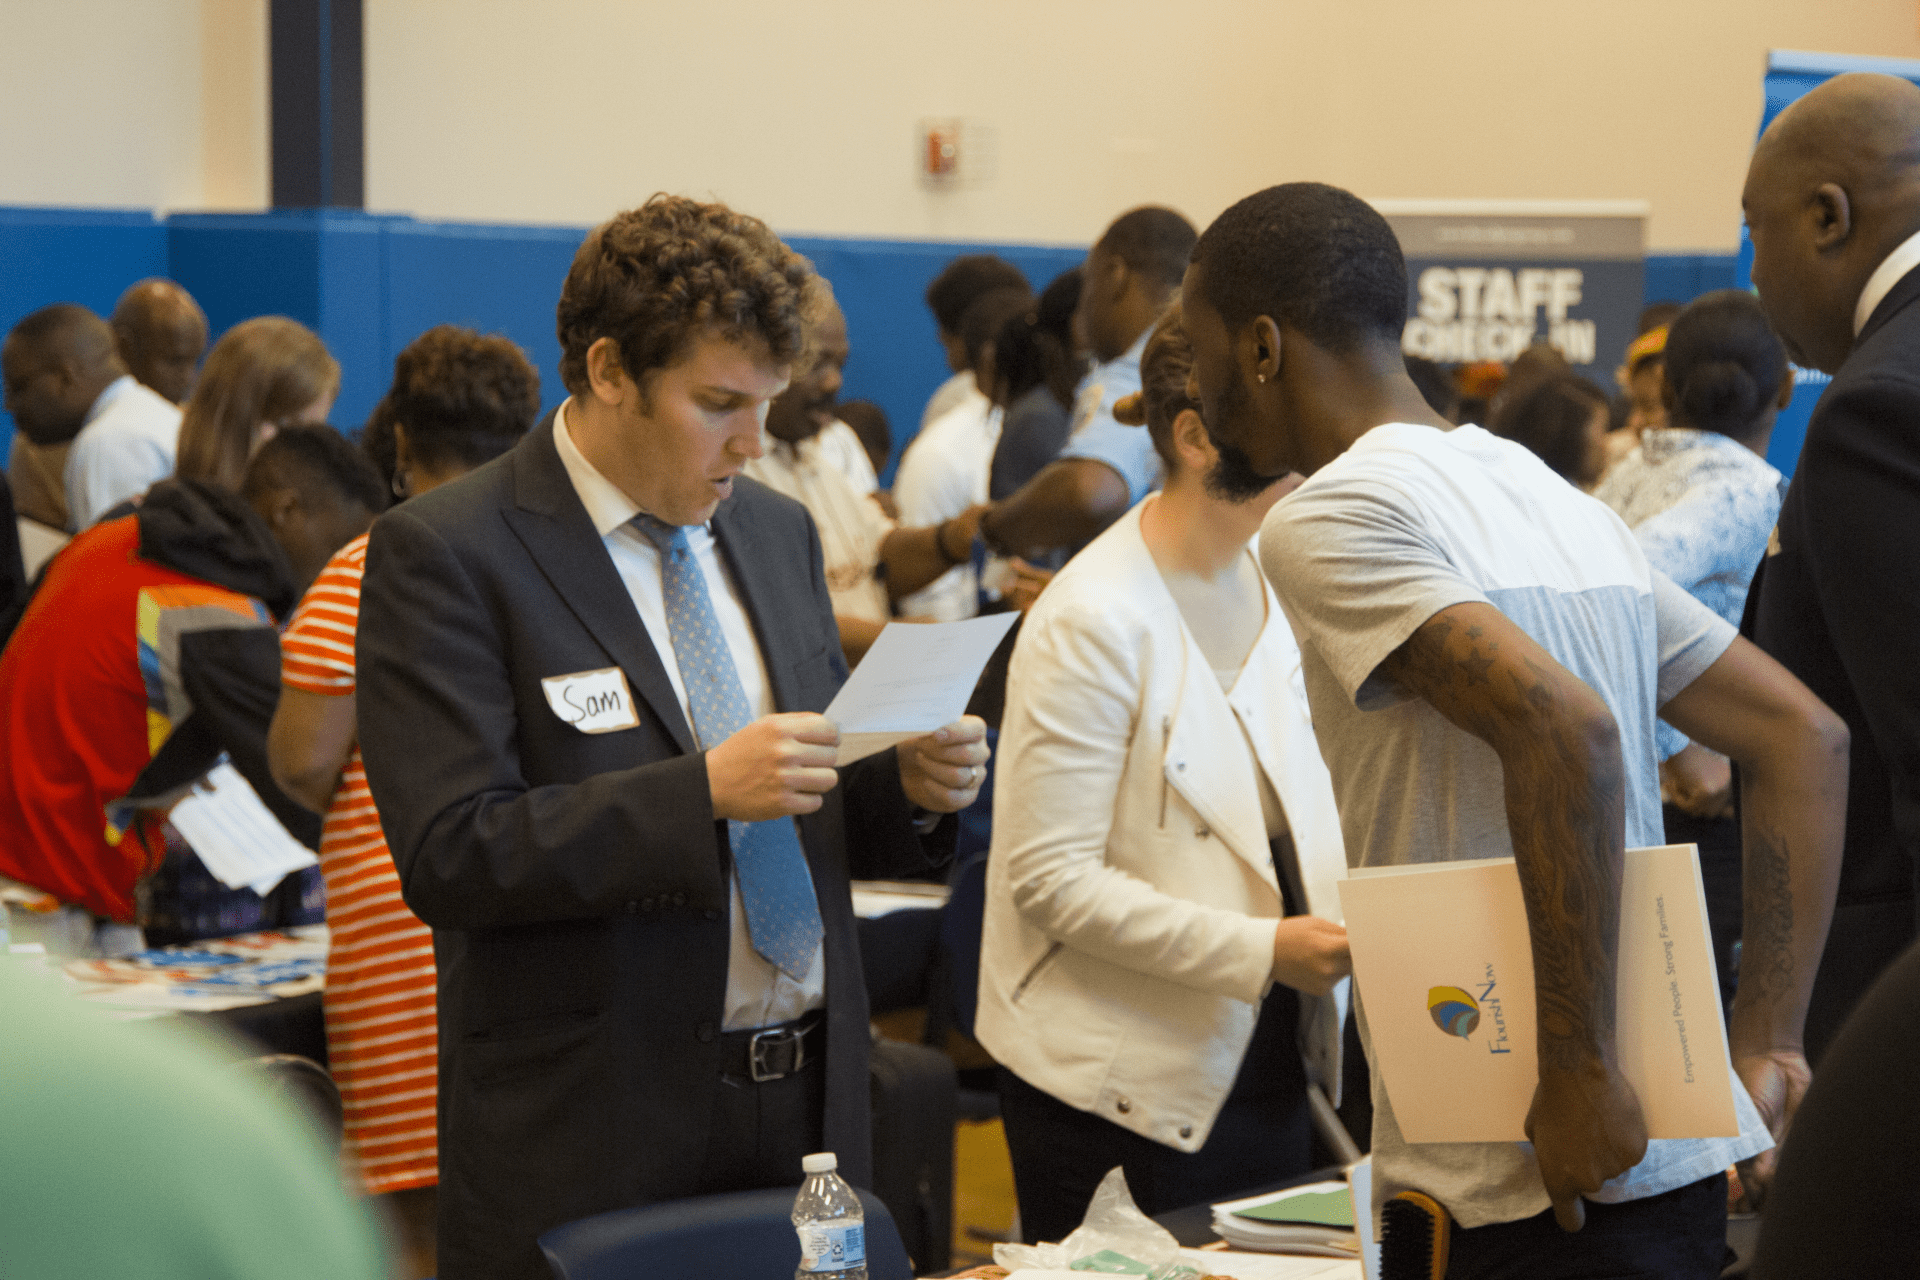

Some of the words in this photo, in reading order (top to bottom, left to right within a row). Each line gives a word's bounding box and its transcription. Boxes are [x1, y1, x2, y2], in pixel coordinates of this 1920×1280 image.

[1417, 267, 1583, 320] STAFF
[563, 684, 621, 723] Sam
[1663, 940, 1676, 976] Strong
[1674, 1019, 1695, 1084] Empowered
